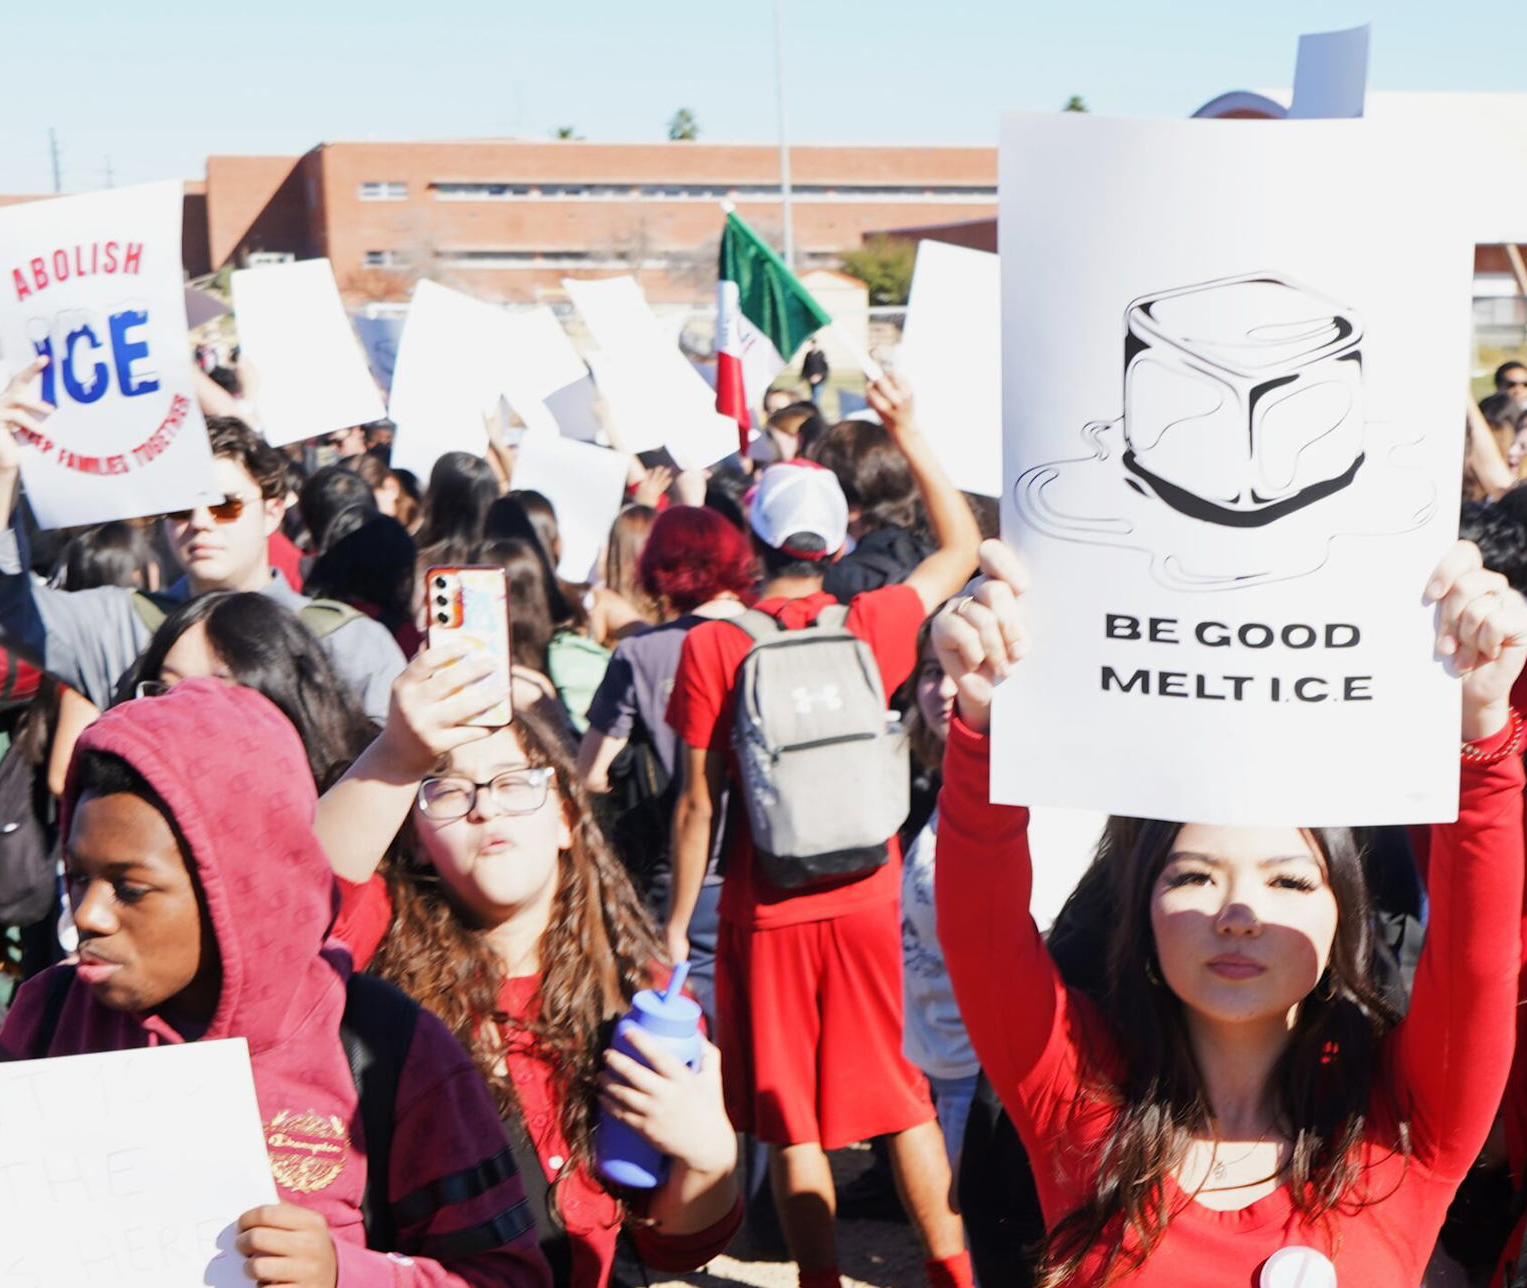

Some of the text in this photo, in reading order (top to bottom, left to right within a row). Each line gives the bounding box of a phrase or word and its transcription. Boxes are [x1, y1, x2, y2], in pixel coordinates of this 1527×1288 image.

[11, 240, 144, 302] ABOLISH
[28, 300, 161, 410] ICE
[1104, 611, 1361, 649] BE GOOD
[1099, 664, 1255, 702] MELT
